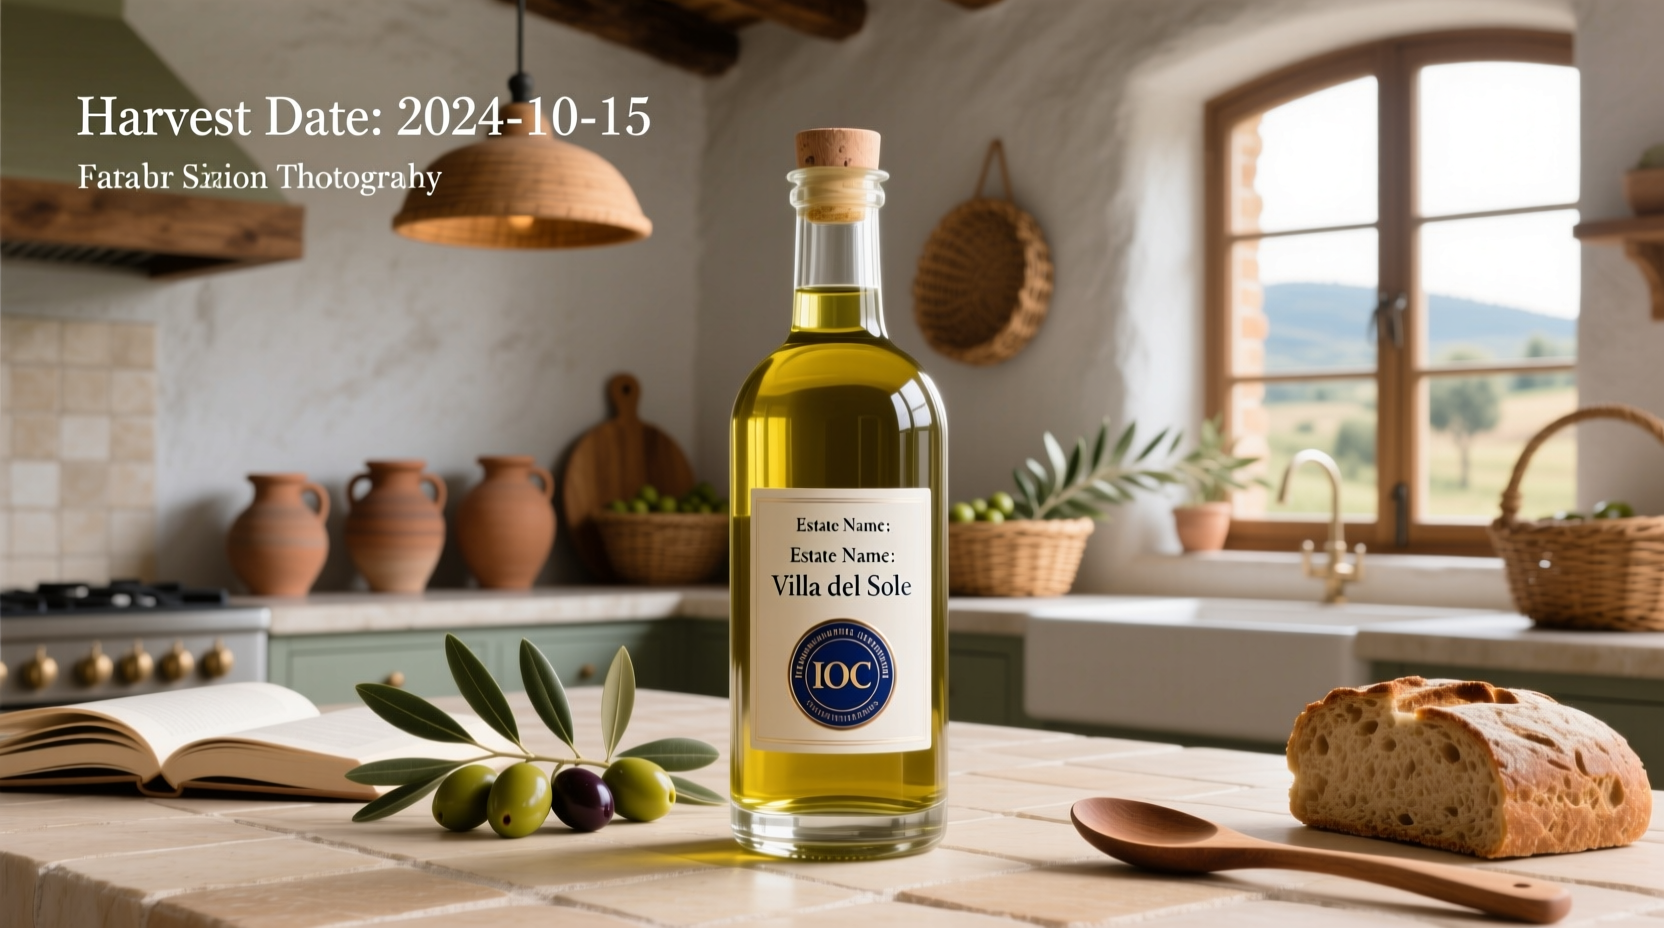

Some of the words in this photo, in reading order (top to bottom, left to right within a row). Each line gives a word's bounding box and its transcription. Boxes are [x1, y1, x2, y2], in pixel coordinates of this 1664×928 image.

[796, 517, 840, 533] Estate
[843, 517, 891, 533] Name:
[790, 546, 837, 563] Estate
[842, 547, 895, 563] Name:
[771, 573, 822, 597] Villa
[827, 574, 861, 597] del
[867, 574, 912, 597] Sole
[812, 661, 872, 690] IOC
